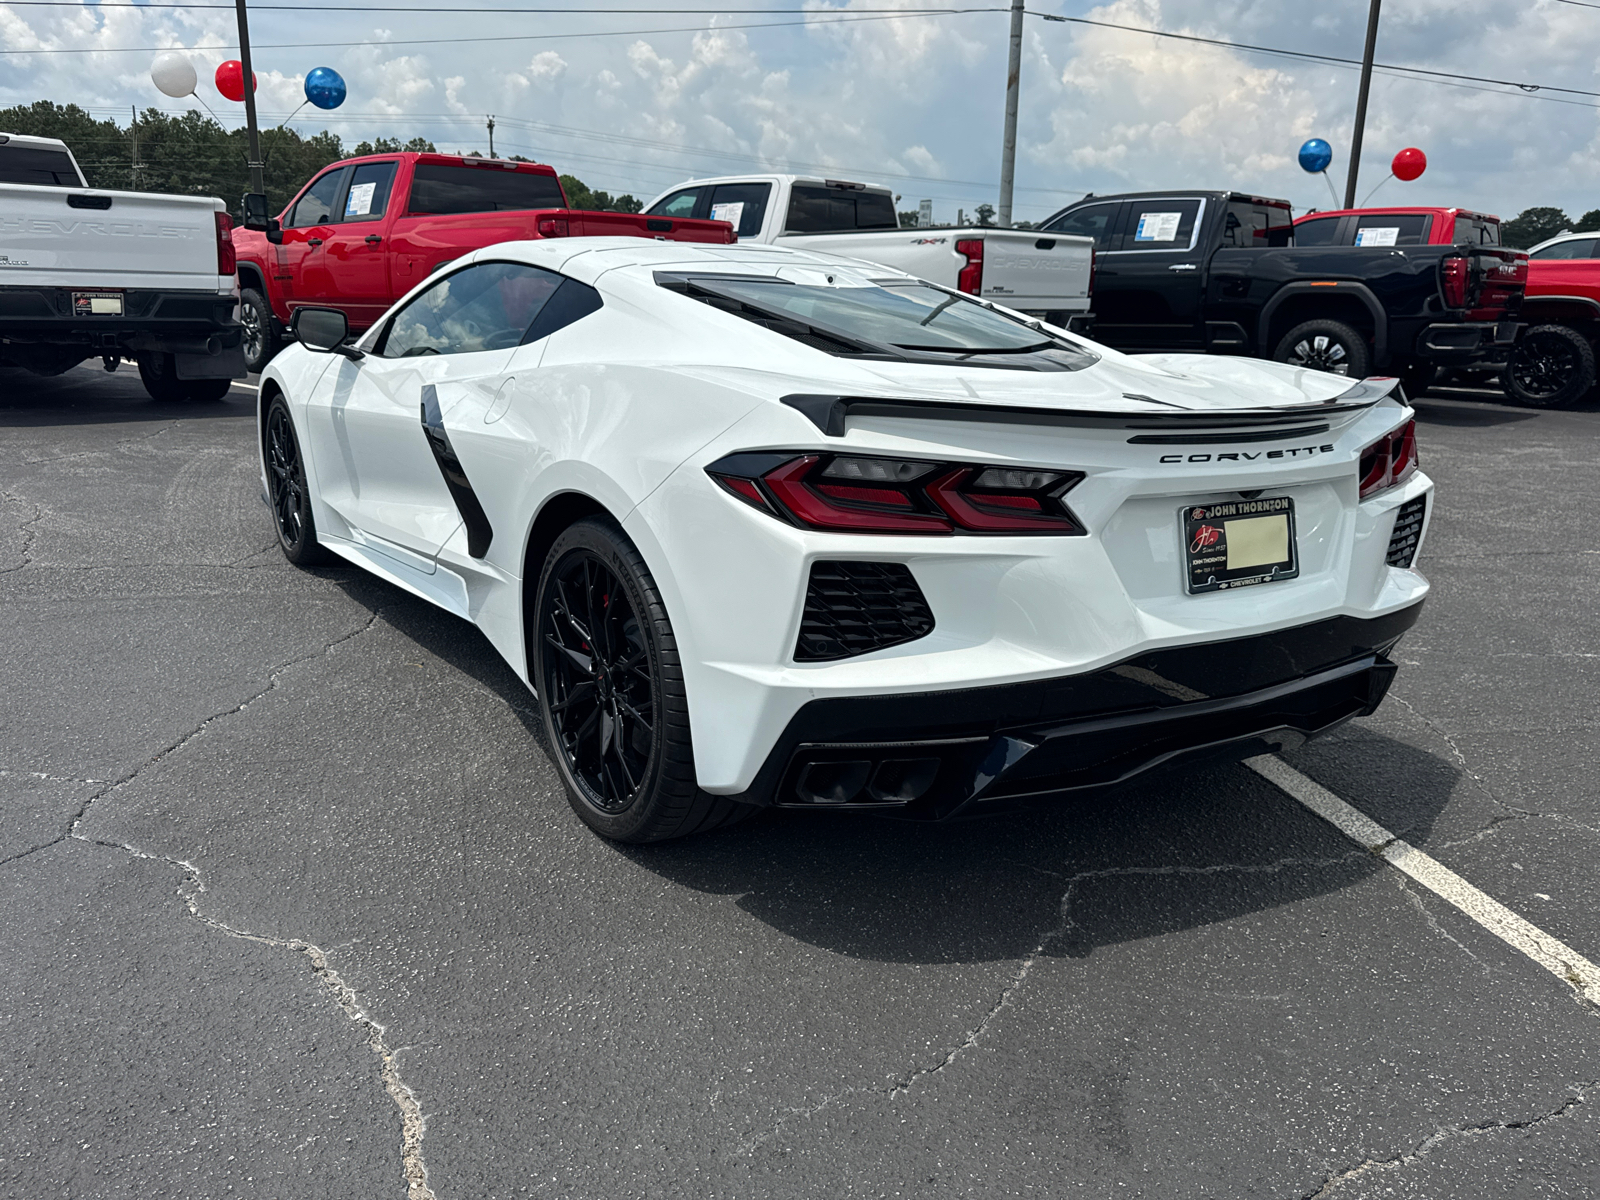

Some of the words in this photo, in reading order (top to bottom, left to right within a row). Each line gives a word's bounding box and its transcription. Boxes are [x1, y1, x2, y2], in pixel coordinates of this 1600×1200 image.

[0, 217, 200, 239] HEVROLET
[993, 257, 1086, 271] CHEVROLET
[1159, 444, 1334, 463] CORVETTE
[1210, 504, 1237, 518] JOHN
[1238, 498, 1289, 514] THORNTON
[1230, 577, 1262, 588] CHEVROLET
[619, 564, 650, 629] MICHELIN
